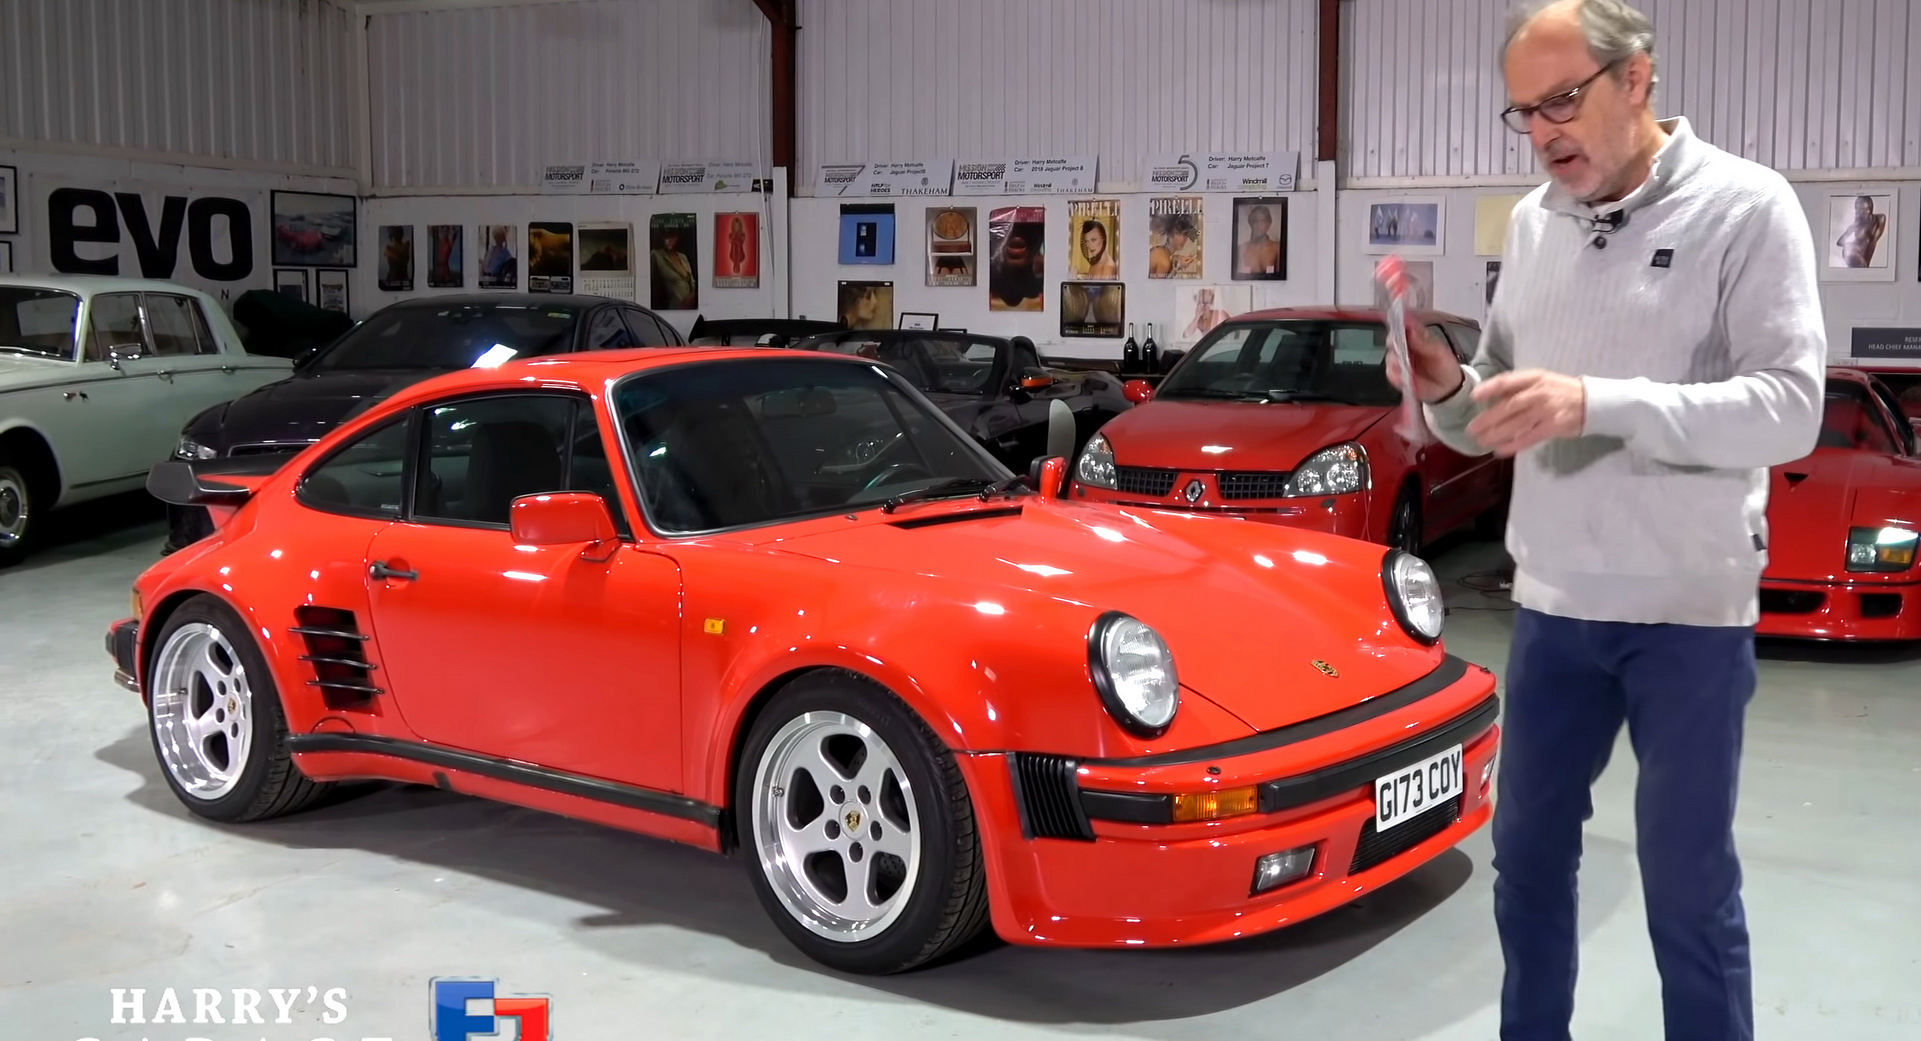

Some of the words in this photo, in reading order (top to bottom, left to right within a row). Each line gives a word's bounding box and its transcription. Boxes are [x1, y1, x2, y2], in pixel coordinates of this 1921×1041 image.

[959, 163, 987, 171] MISSION
[544, 172, 584, 181] MOTORSPORT
[662, 174, 704, 183] MOTORSPORT
[958, 171, 1004, 180] MOTORSPORT
[1069, 201, 1120, 216] PIRELLI
[1150, 199, 1202, 215] PIRELLI
[48, 187, 254, 282] evo
[1380, 768, 1424, 823] G173
[1429, 750, 1461, 801] COY
